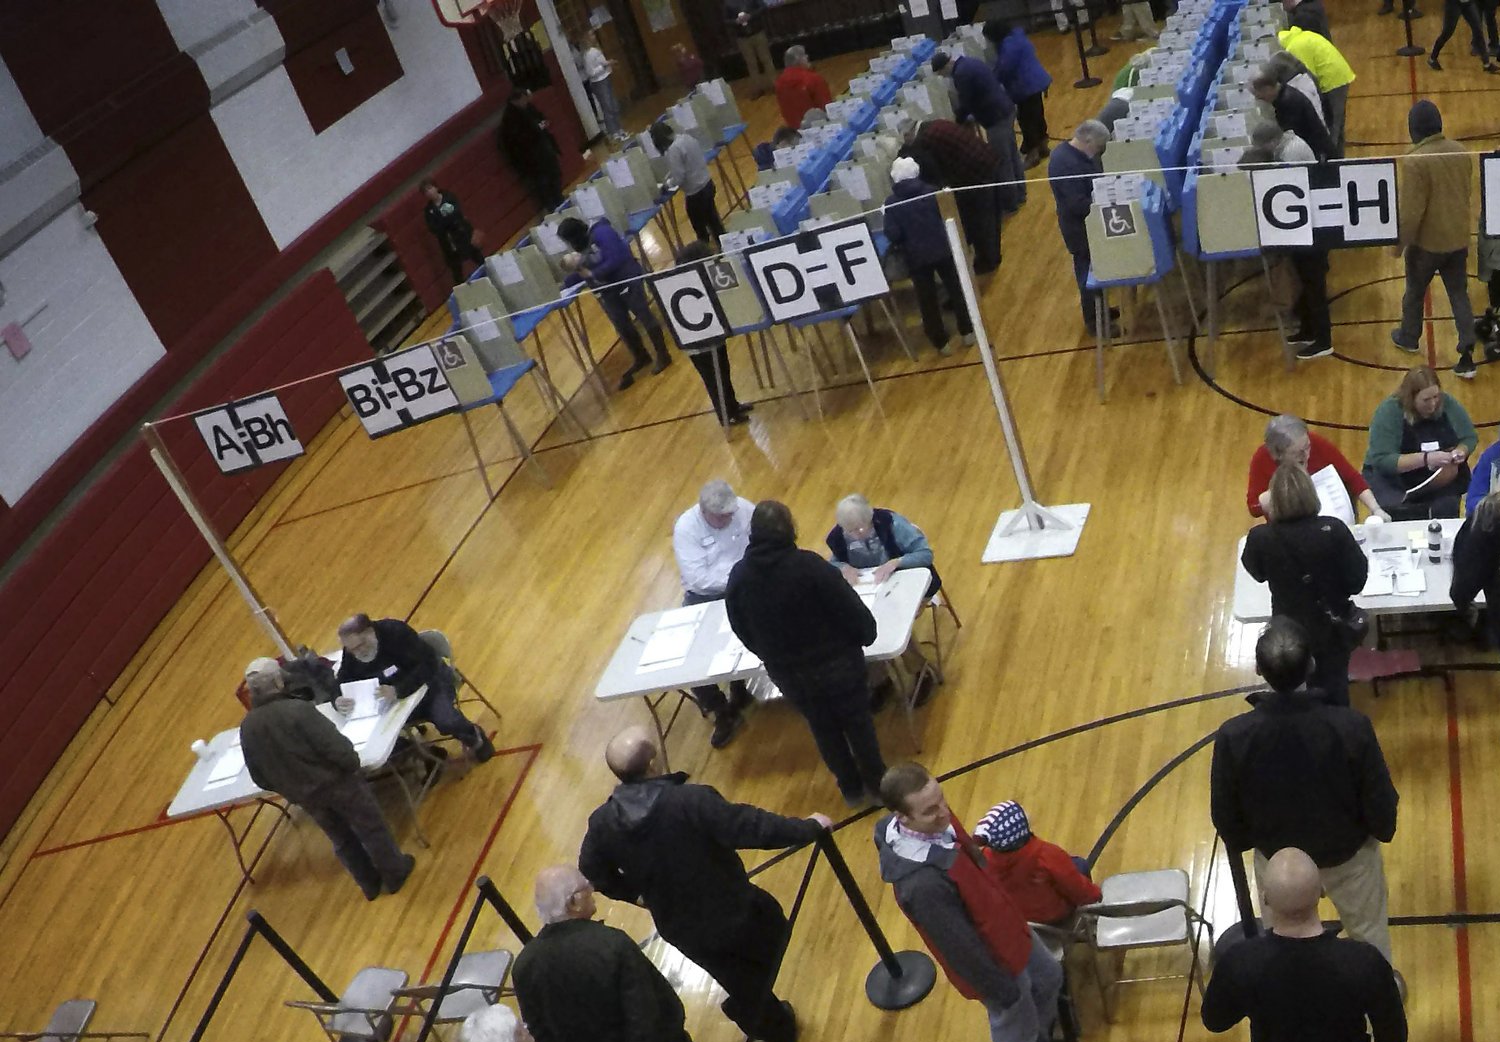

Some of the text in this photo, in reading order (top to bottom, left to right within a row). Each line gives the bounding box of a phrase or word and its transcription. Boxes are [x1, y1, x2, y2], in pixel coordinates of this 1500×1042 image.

[1262, 178, 1390, 230] G-H
[762, 240, 868, 304] D-F
[670, 287, 713, 331] C
